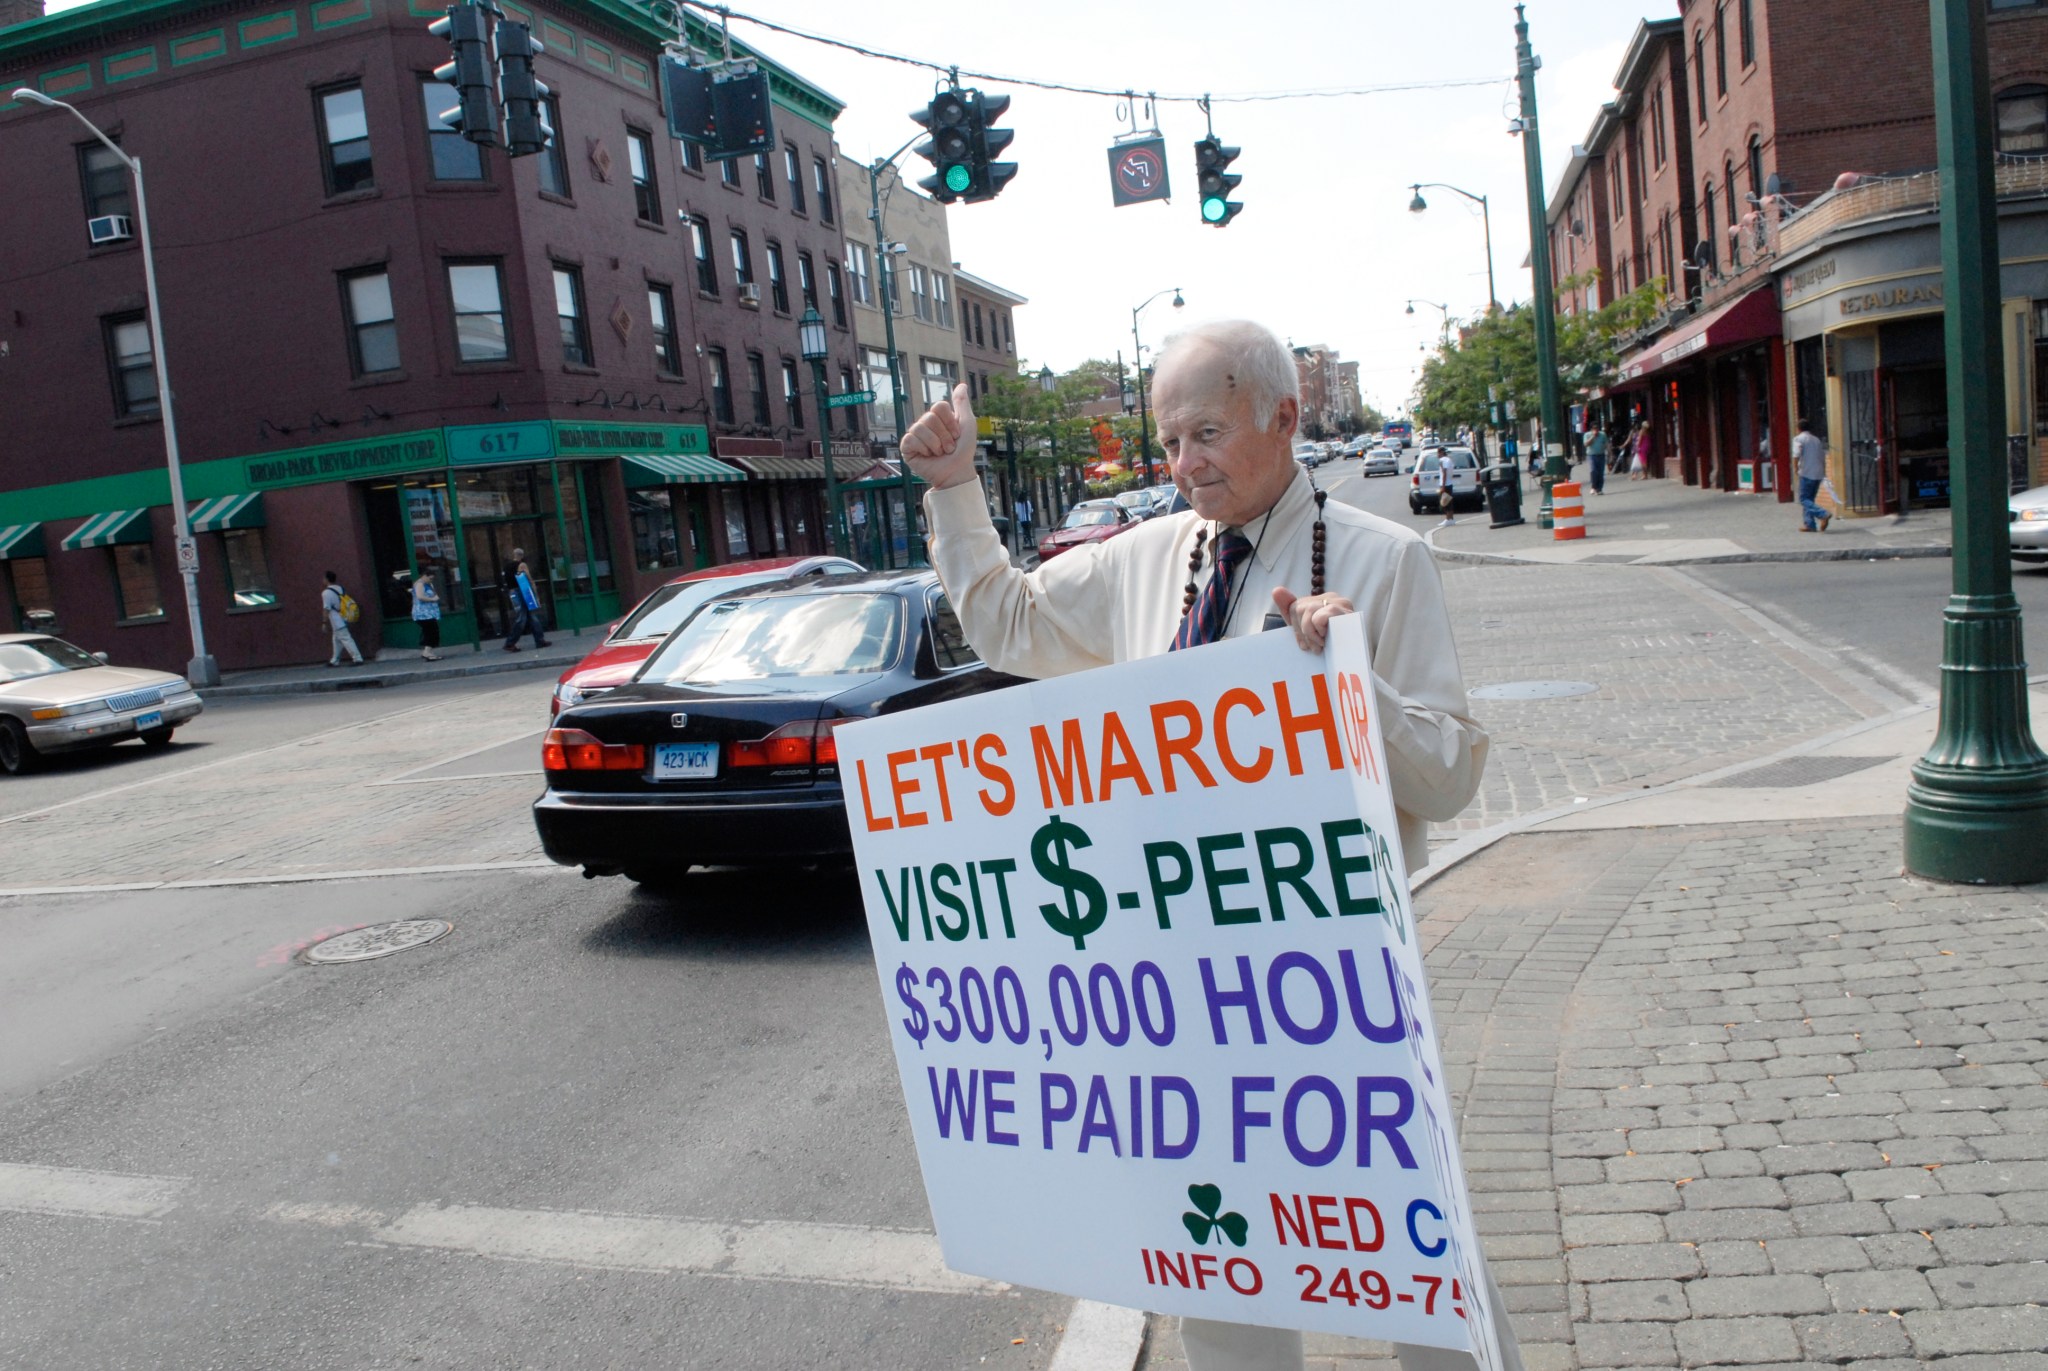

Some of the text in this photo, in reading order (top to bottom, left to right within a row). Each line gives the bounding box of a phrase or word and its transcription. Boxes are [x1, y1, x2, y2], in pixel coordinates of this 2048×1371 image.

[1840, 285, 1943, 315] RESTAURAN
[830, 394, 862, 406] BROAD ST
[250, 456, 317, 483] BROAD-PARK
[318, 444, 402, 473] DEVELOPMENT
[480, 432, 519, 453] 617
[680, 433, 697, 448] 619
[856, 671, 1379, 832] LET'S MARCH OR
[876, 858, 1017, 942] VISIT
[895, 960, 1176, 1062] $300,000
[927, 1066, 1019, 1147] WE
[1040, 1071, 1200, 1160] PAID
[1231, 1075, 1419, 1170] FOR
[1268, 1192, 1385, 1253] NED
[1141, 1249, 1263, 1296] INFO
